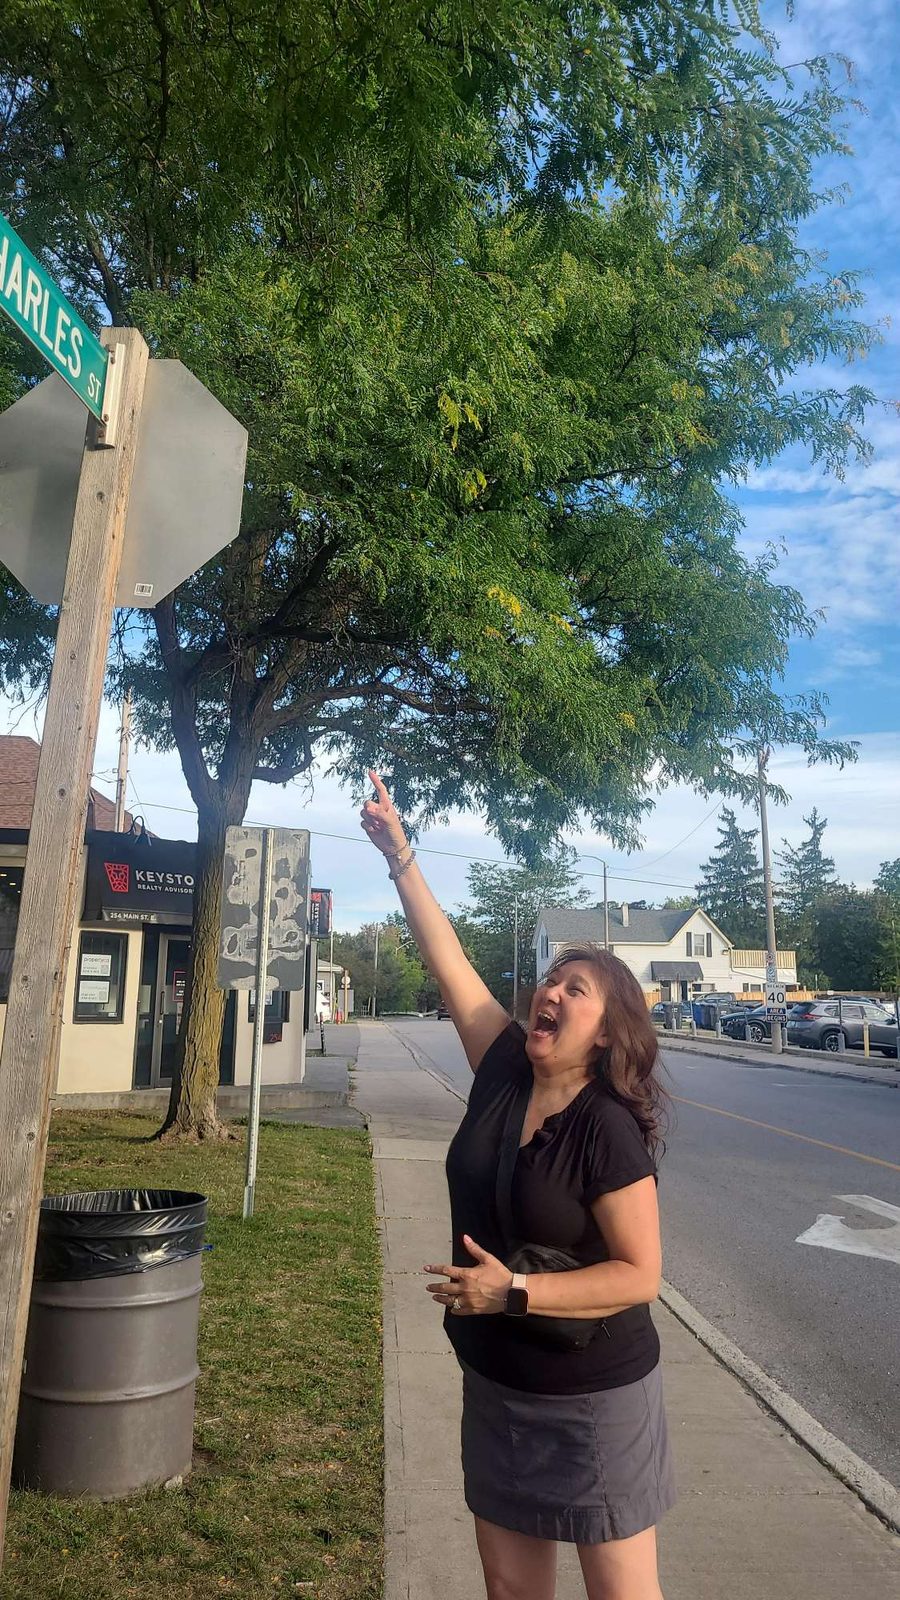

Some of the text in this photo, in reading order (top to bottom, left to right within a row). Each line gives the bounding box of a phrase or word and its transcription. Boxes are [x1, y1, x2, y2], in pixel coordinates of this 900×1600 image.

[88, 372, 102, 404] ST
[135, 870, 194, 886] KEYSTO
[137, 884, 195, 895] REALTY ADVISOR
[768, 992, 785, 1003] 40
